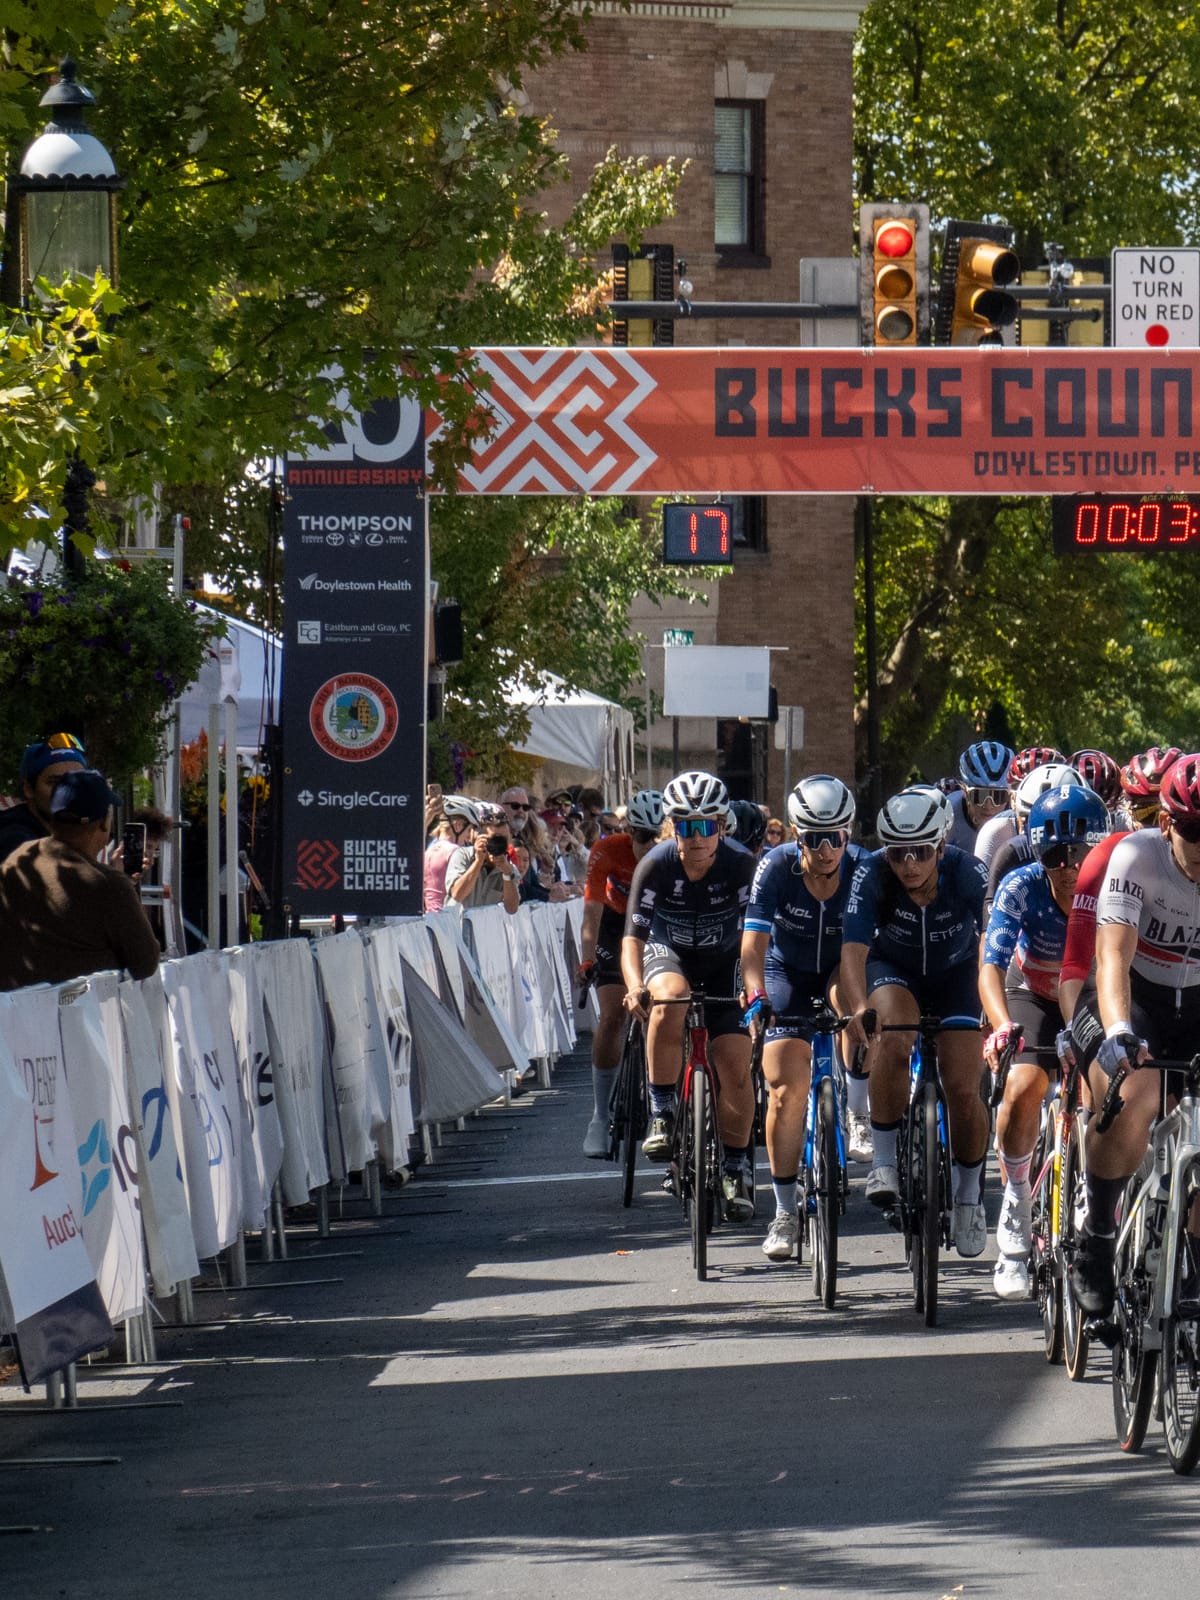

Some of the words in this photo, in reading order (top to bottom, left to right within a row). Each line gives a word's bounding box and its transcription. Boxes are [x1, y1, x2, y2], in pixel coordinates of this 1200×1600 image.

[1140, 255, 1175, 274] NO
[1132, 281, 1183, 297] TURN
[1121, 304, 1147, 320] ON
[1156, 304, 1193, 320] RED
[714, 367, 962, 437] BUCKS
[288, 469, 423, 485] ANNIVERSARY
[298, 516, 412, 531] THOMPSON
[690, 510, 728, 554] 17
[315, 579, 375, 593] Doylestown
[378, 579, 412, 590] Health
[377, 624, 397, 633] Gray,
[318, 791, 407, 809] SingleCare
[344, 840, 396, 855] BUCKS
[344, 858, 408, 873] COUNTY
[344, 875, 409, 890] CLASSIC
[785, 903, 813, 919] NCL
[895, 908, 919, 922] NCL
